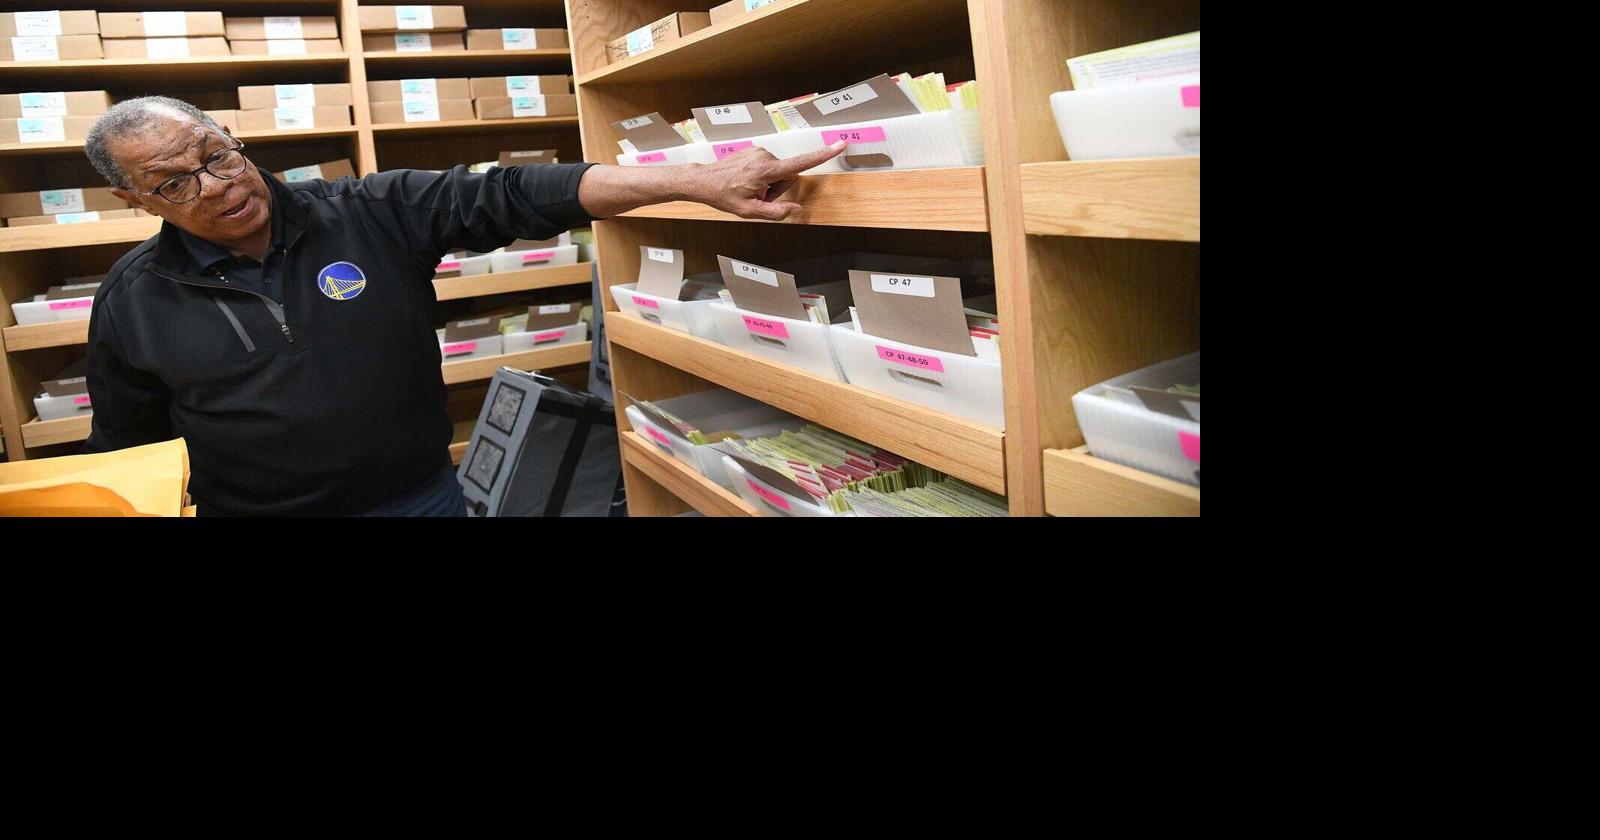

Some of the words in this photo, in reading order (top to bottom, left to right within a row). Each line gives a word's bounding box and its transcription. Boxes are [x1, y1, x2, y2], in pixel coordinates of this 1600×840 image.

[831, 97, 840, 106] CP
[842, 93, 853, 102] 41
[714, 107, 722, 115] CP
[840, 133, 848, 141] CP
[888, 278, 899, 286] CP
